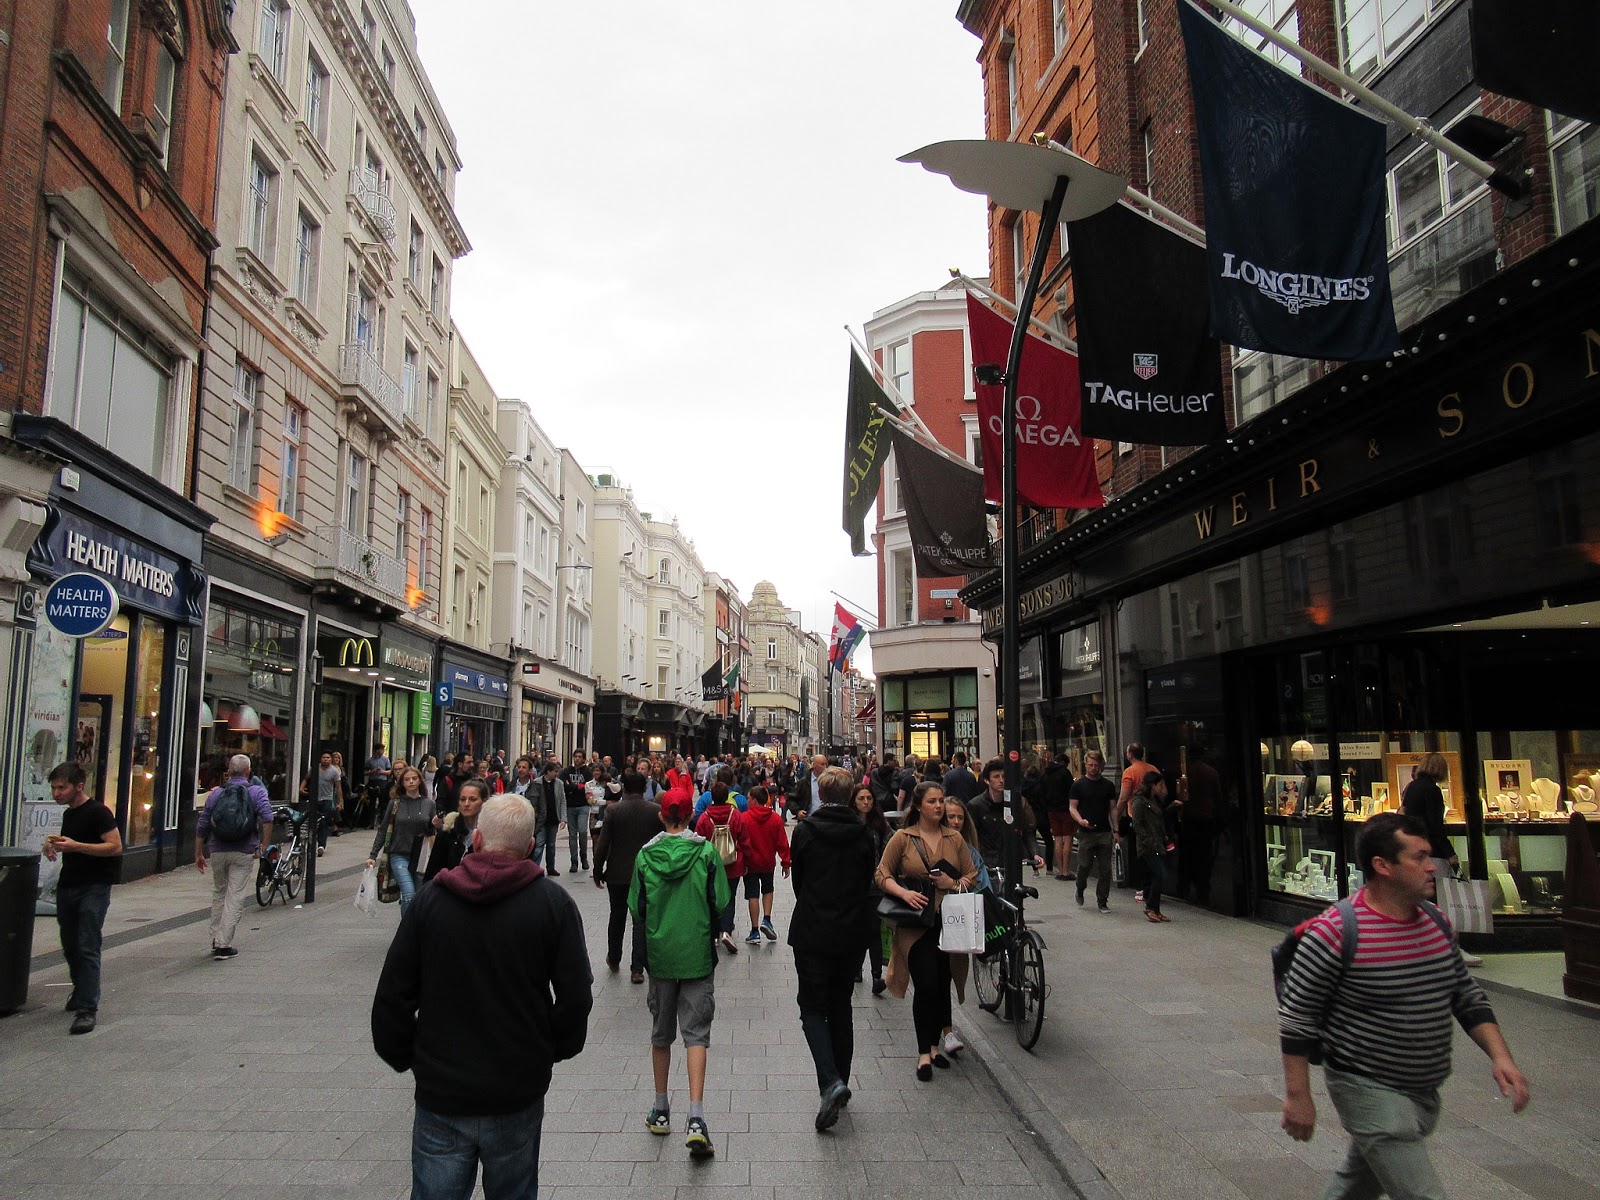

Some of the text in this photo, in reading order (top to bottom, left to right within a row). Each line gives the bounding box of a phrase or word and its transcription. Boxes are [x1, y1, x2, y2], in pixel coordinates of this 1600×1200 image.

[1220, 252, 1371, 301] LONGINES
[1137, 356, 1154, 366] TAG
[1135, 367, 1156, 378] HEUER
[1193, 458, 1322, 541] WEIR
[1368, 438, 1380, 460] &
[917, 544, 944, 557] PATEK
[67, 530, 174, 598] HEALTH MATTERS
[56, 588, 104, 602] HEALTH
[1020, 584, 1053, 617] SONS
[49, 604, 108, 619] MATTERS
[439, 686, 449, 702] S
[703, 685, 722, 695] M&S
[33, 710, 61, 722] viridian
[34, 809, 49, 828] 10
[943, 914, 966, 925] LOVE
